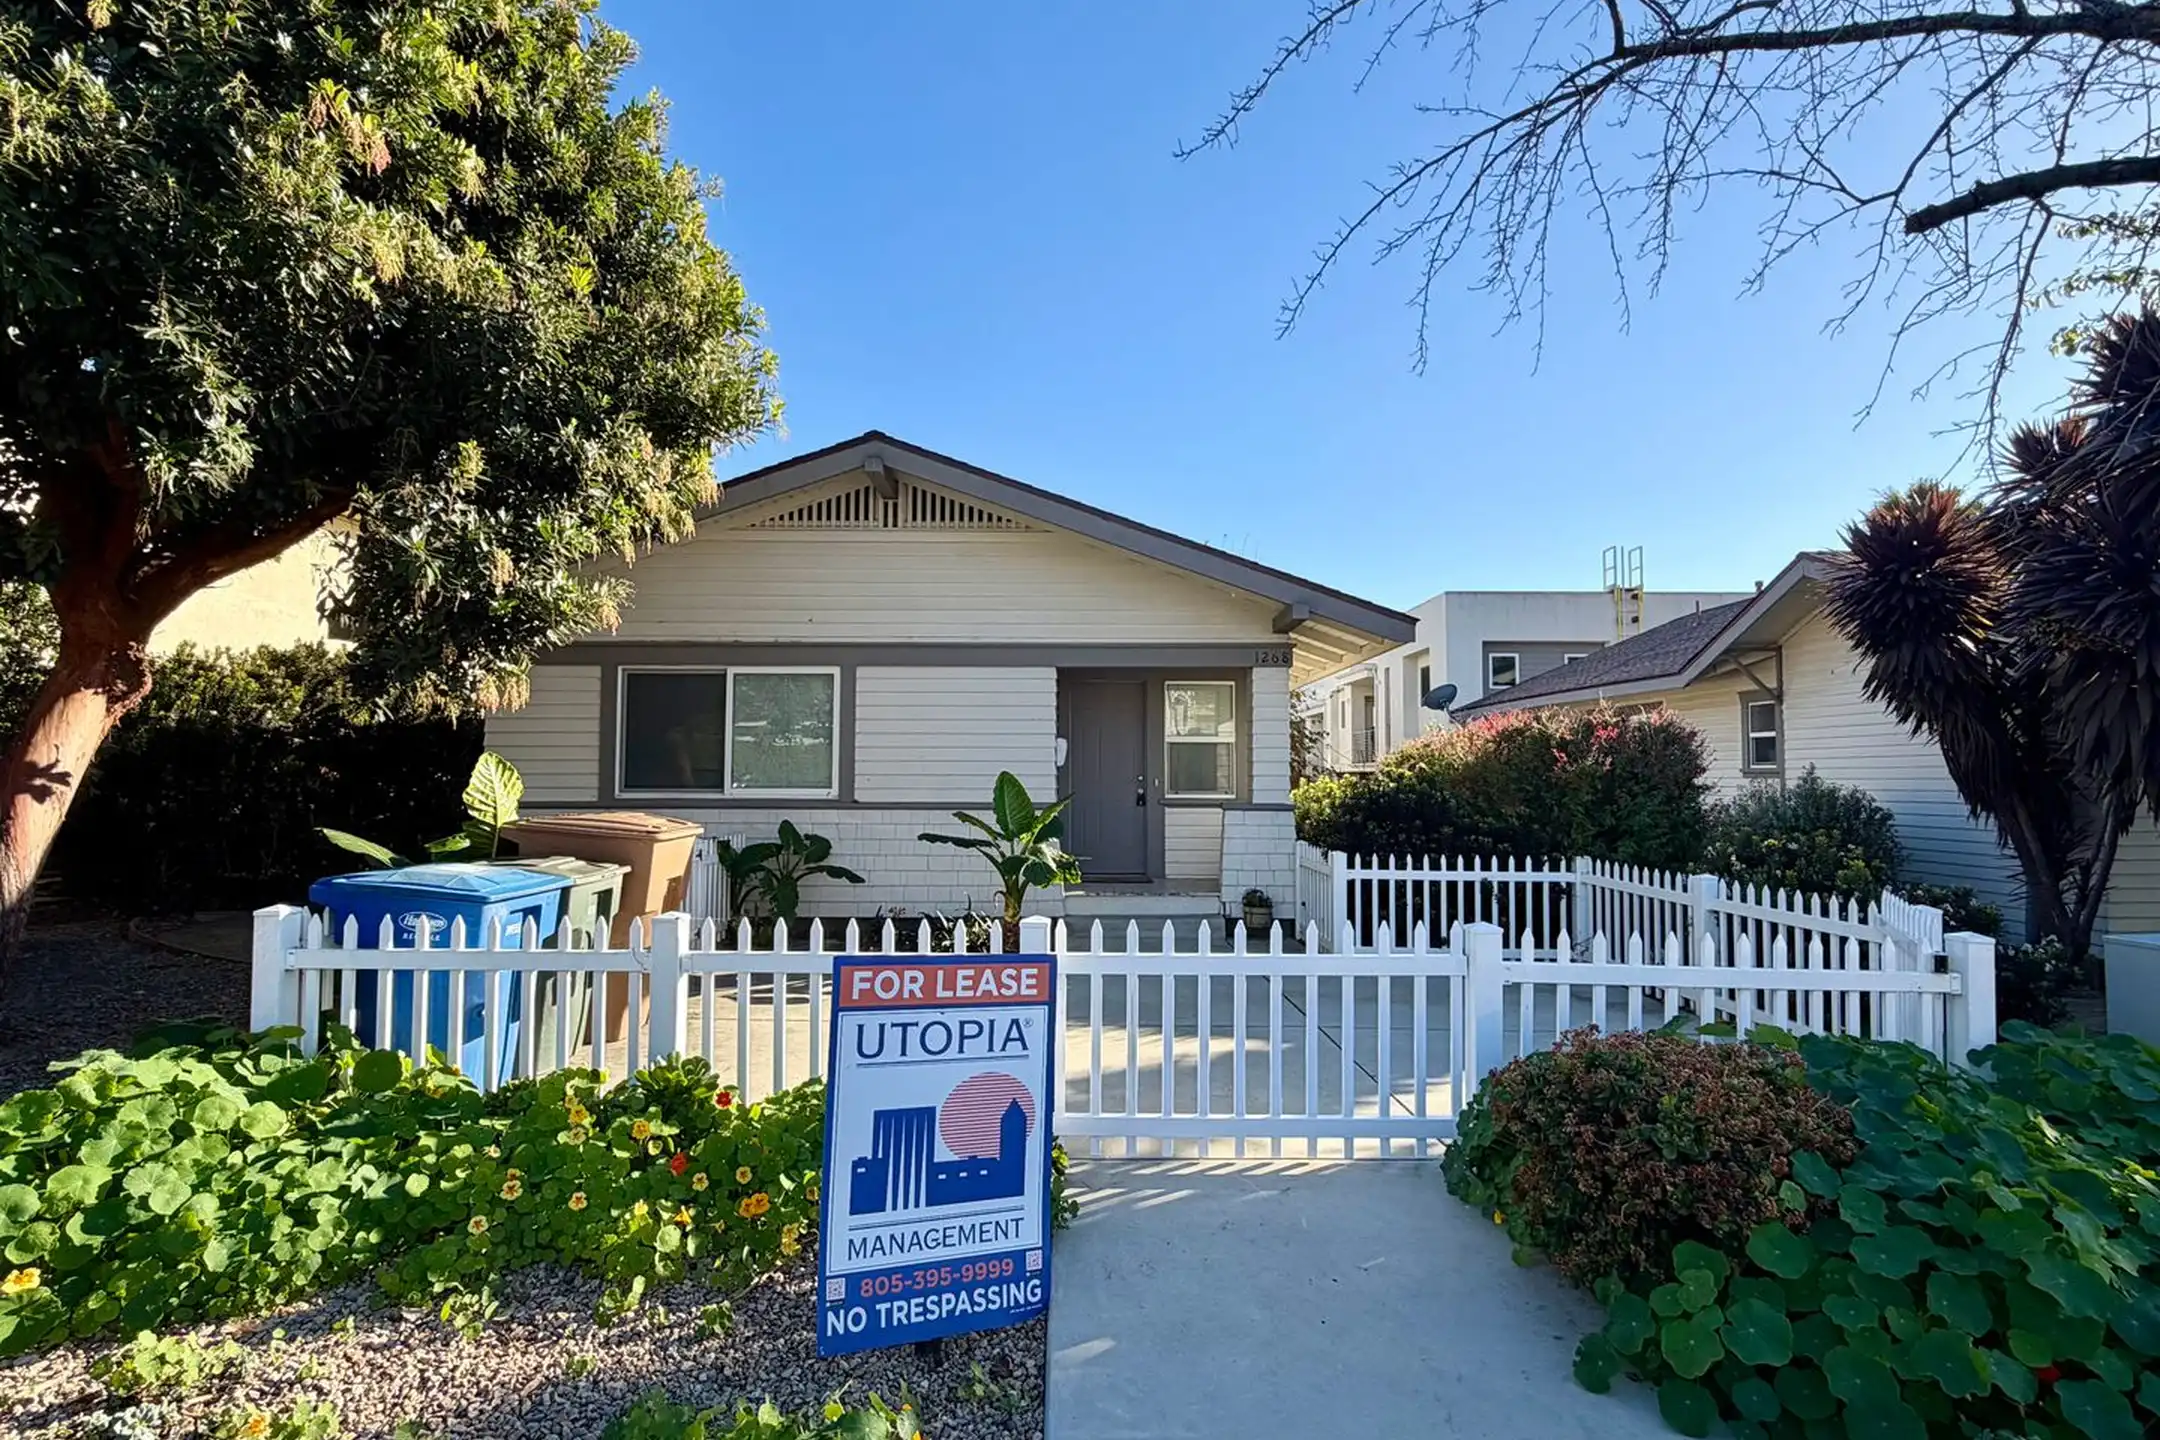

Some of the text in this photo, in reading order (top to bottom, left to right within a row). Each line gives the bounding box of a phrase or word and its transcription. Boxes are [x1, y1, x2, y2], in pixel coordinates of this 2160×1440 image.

[852, 968, 1039, 1000] FOR LEASE
[848, 1217, 1025, 1261] MANAGEMENT
[860, 1258, 1014, 1298] 805-395-9999
[826, 1279, 1042, 1337] NO TRESPASSING
